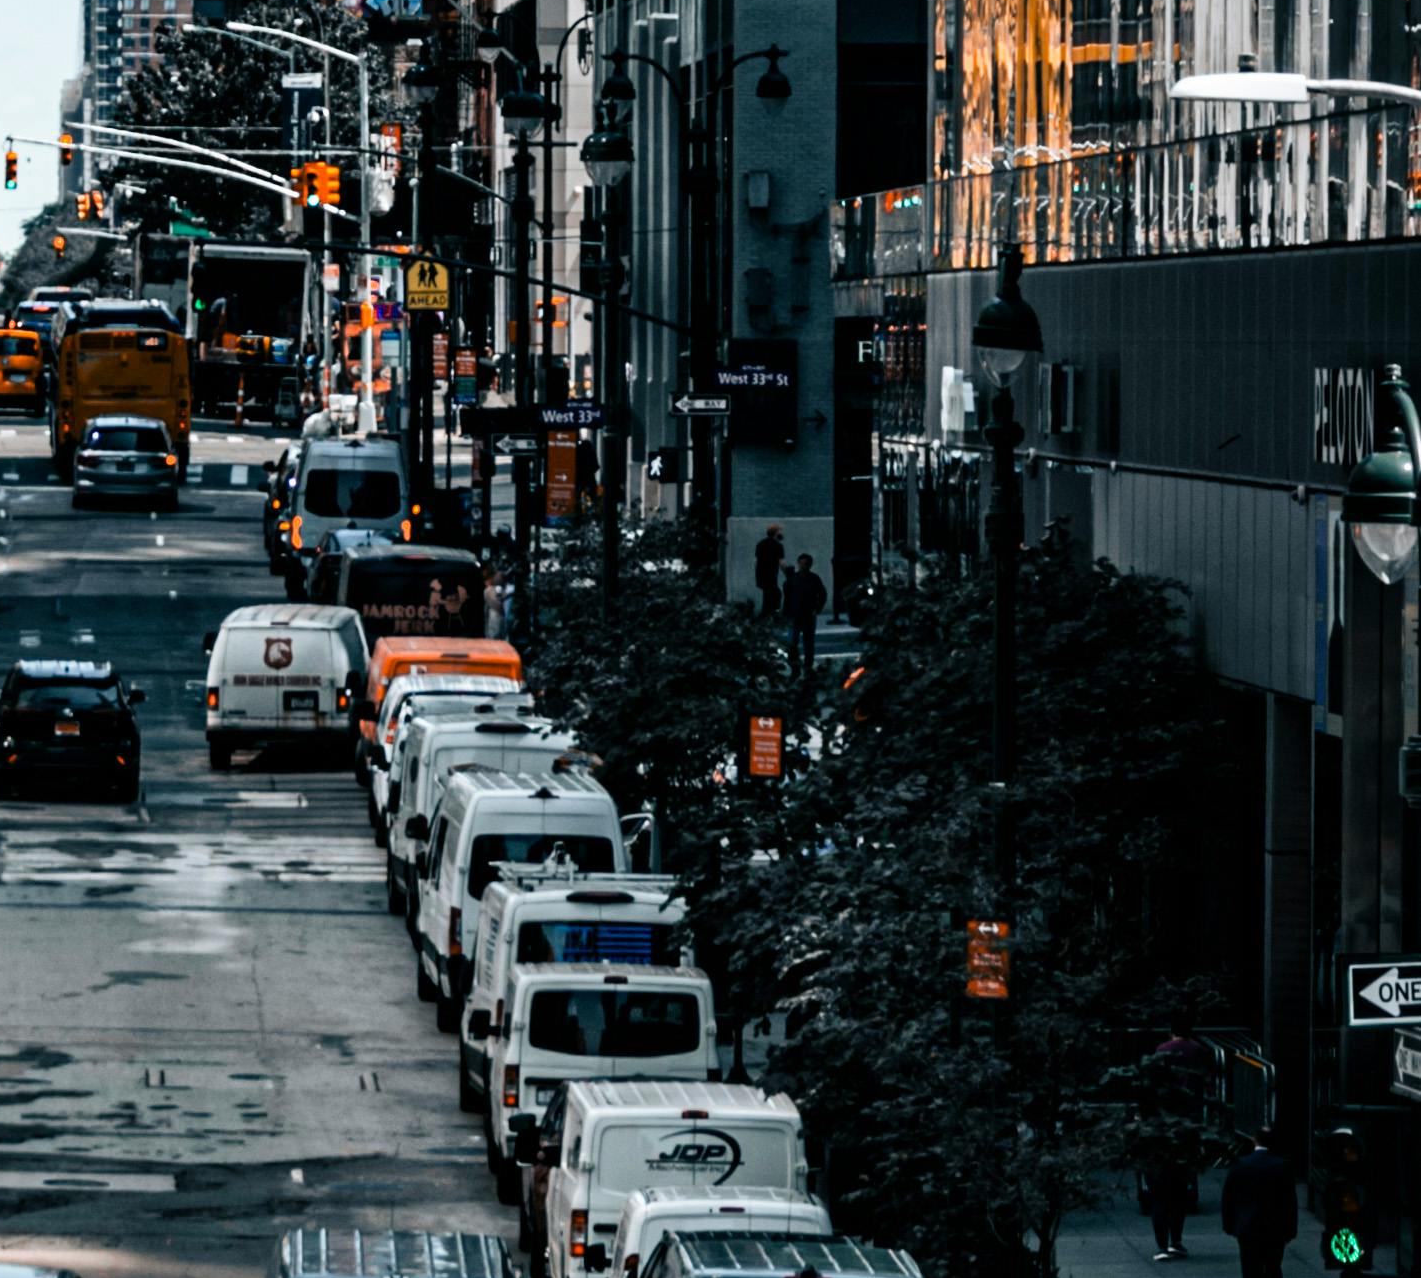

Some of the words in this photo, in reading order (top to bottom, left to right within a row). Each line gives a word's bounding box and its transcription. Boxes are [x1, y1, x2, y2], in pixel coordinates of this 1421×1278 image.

[409, 296, 447, 306] AHEAD
[718, 372, 748, 385] West
[751, 372, 773, 385] 33rd
[776, 373, 789, 386] St
[542, 410, 574, 423] West
[578, 410, 601, 423] 33rd
[1314, 368, 1374, 465] PELOTON
[362, 603, 441, 620] JAMROCK
